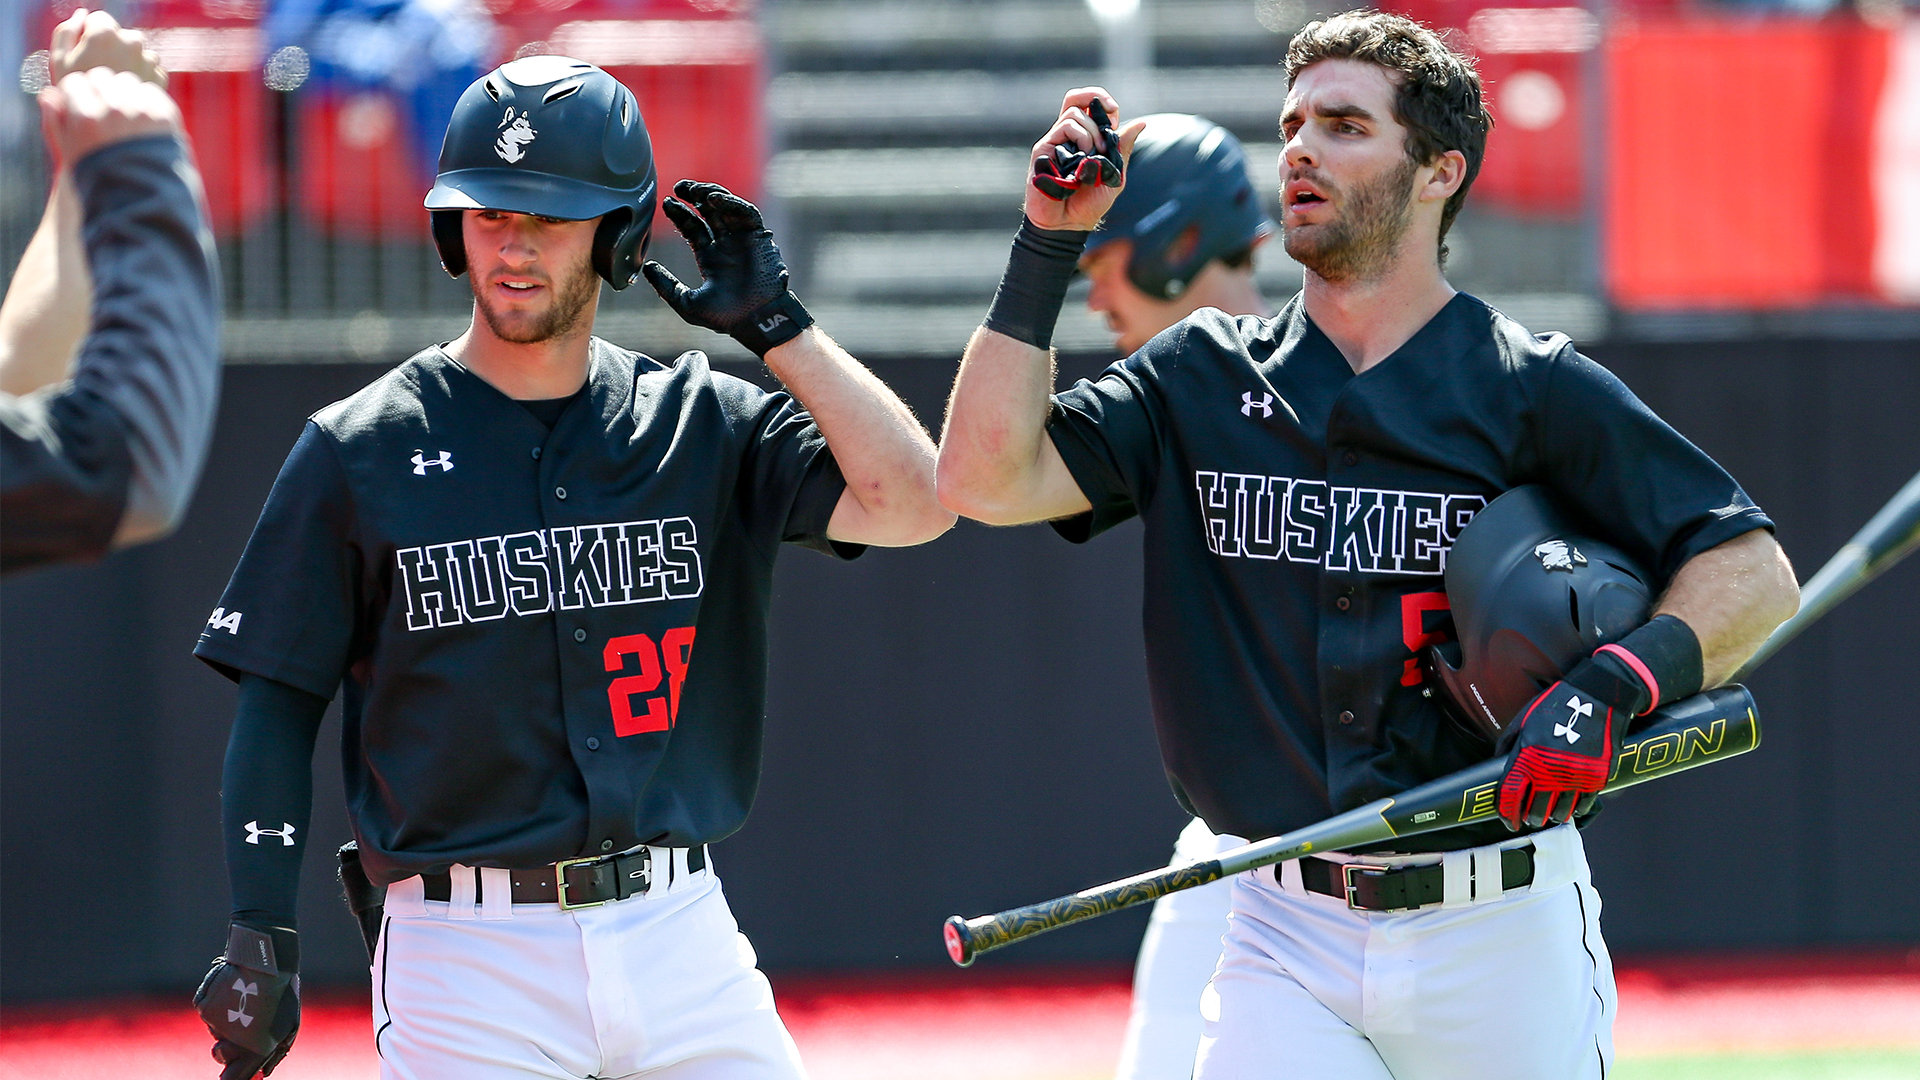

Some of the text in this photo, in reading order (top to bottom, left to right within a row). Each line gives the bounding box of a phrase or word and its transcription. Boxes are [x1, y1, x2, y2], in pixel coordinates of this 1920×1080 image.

[758, 314, 789, 332] UA
[396, 516, 704, 631] HUSKIES
[1458, 718, 1727, 822] ETON
